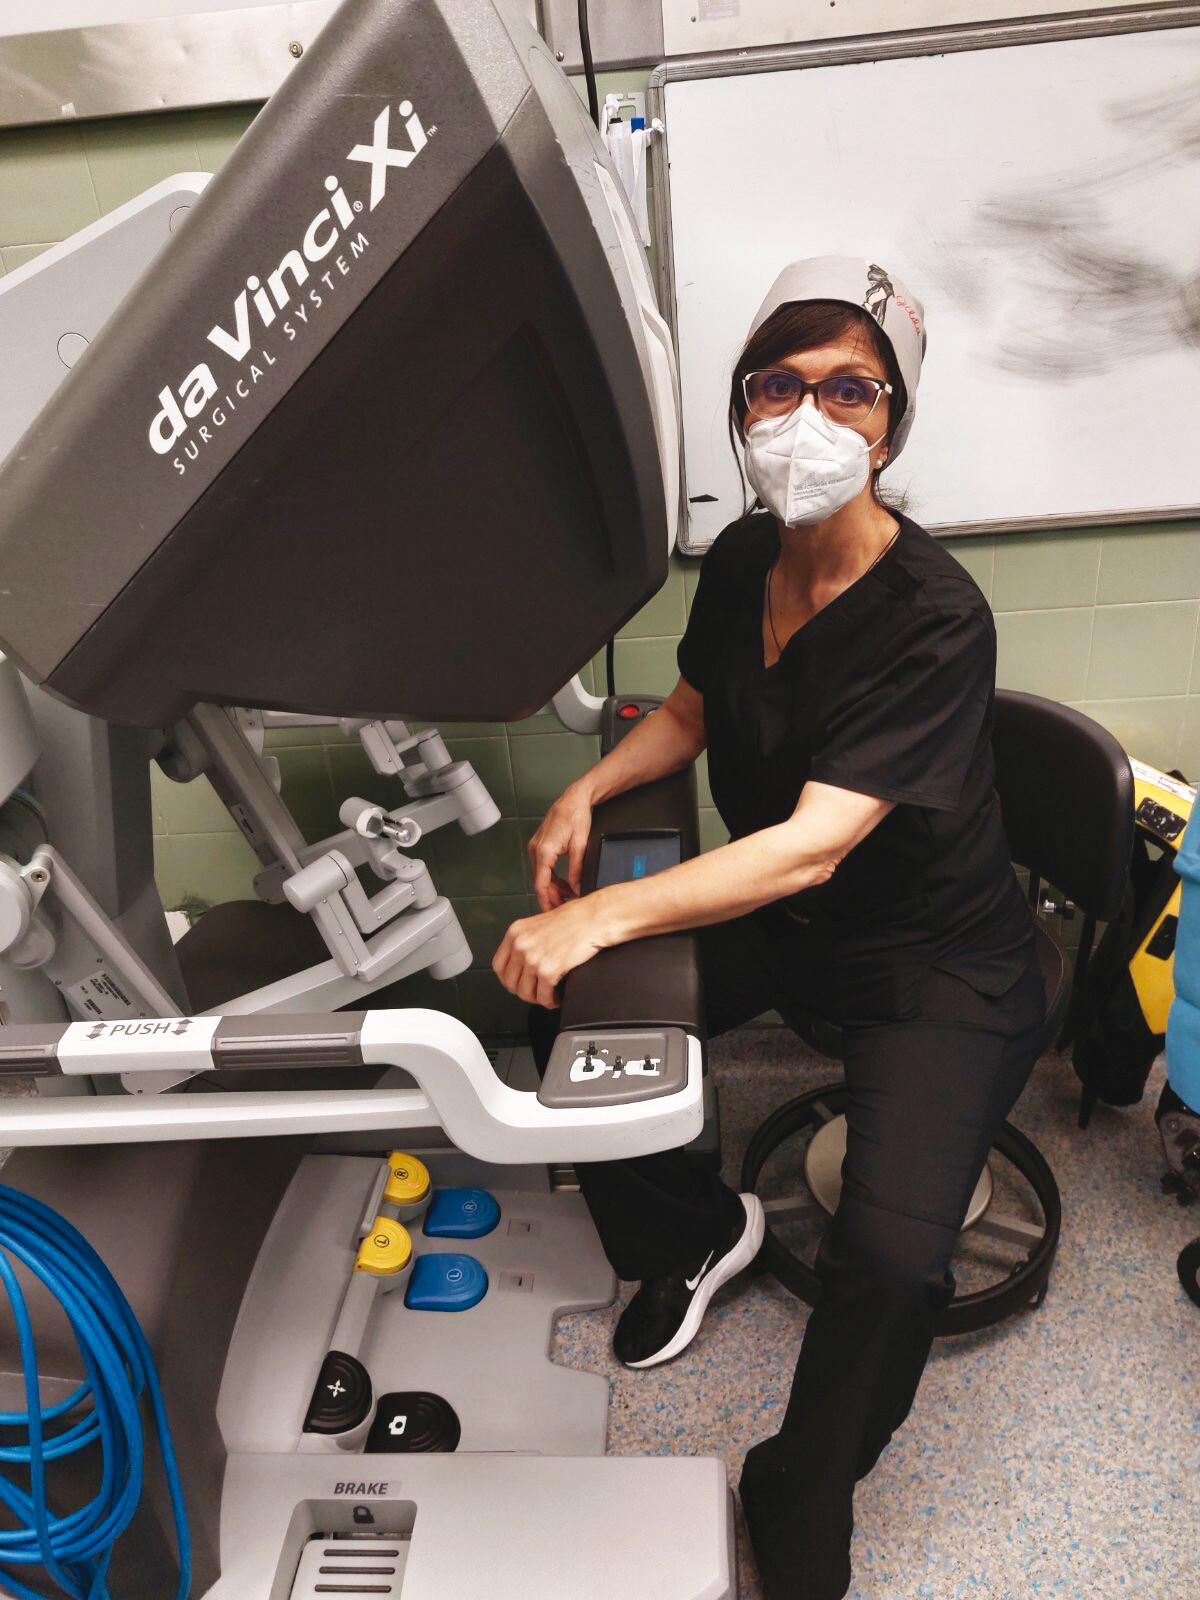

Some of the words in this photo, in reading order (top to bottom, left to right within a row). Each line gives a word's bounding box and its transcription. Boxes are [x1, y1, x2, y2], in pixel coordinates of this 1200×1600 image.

[173, 350, 276, 475] SURGICAL
[283, 232, 370, 340] SYSTEM
[148, 362, 219, 455] da
[109, 1022, 172, 1037] PUSH
[333, 1482, 389, 1495] BRAKE
